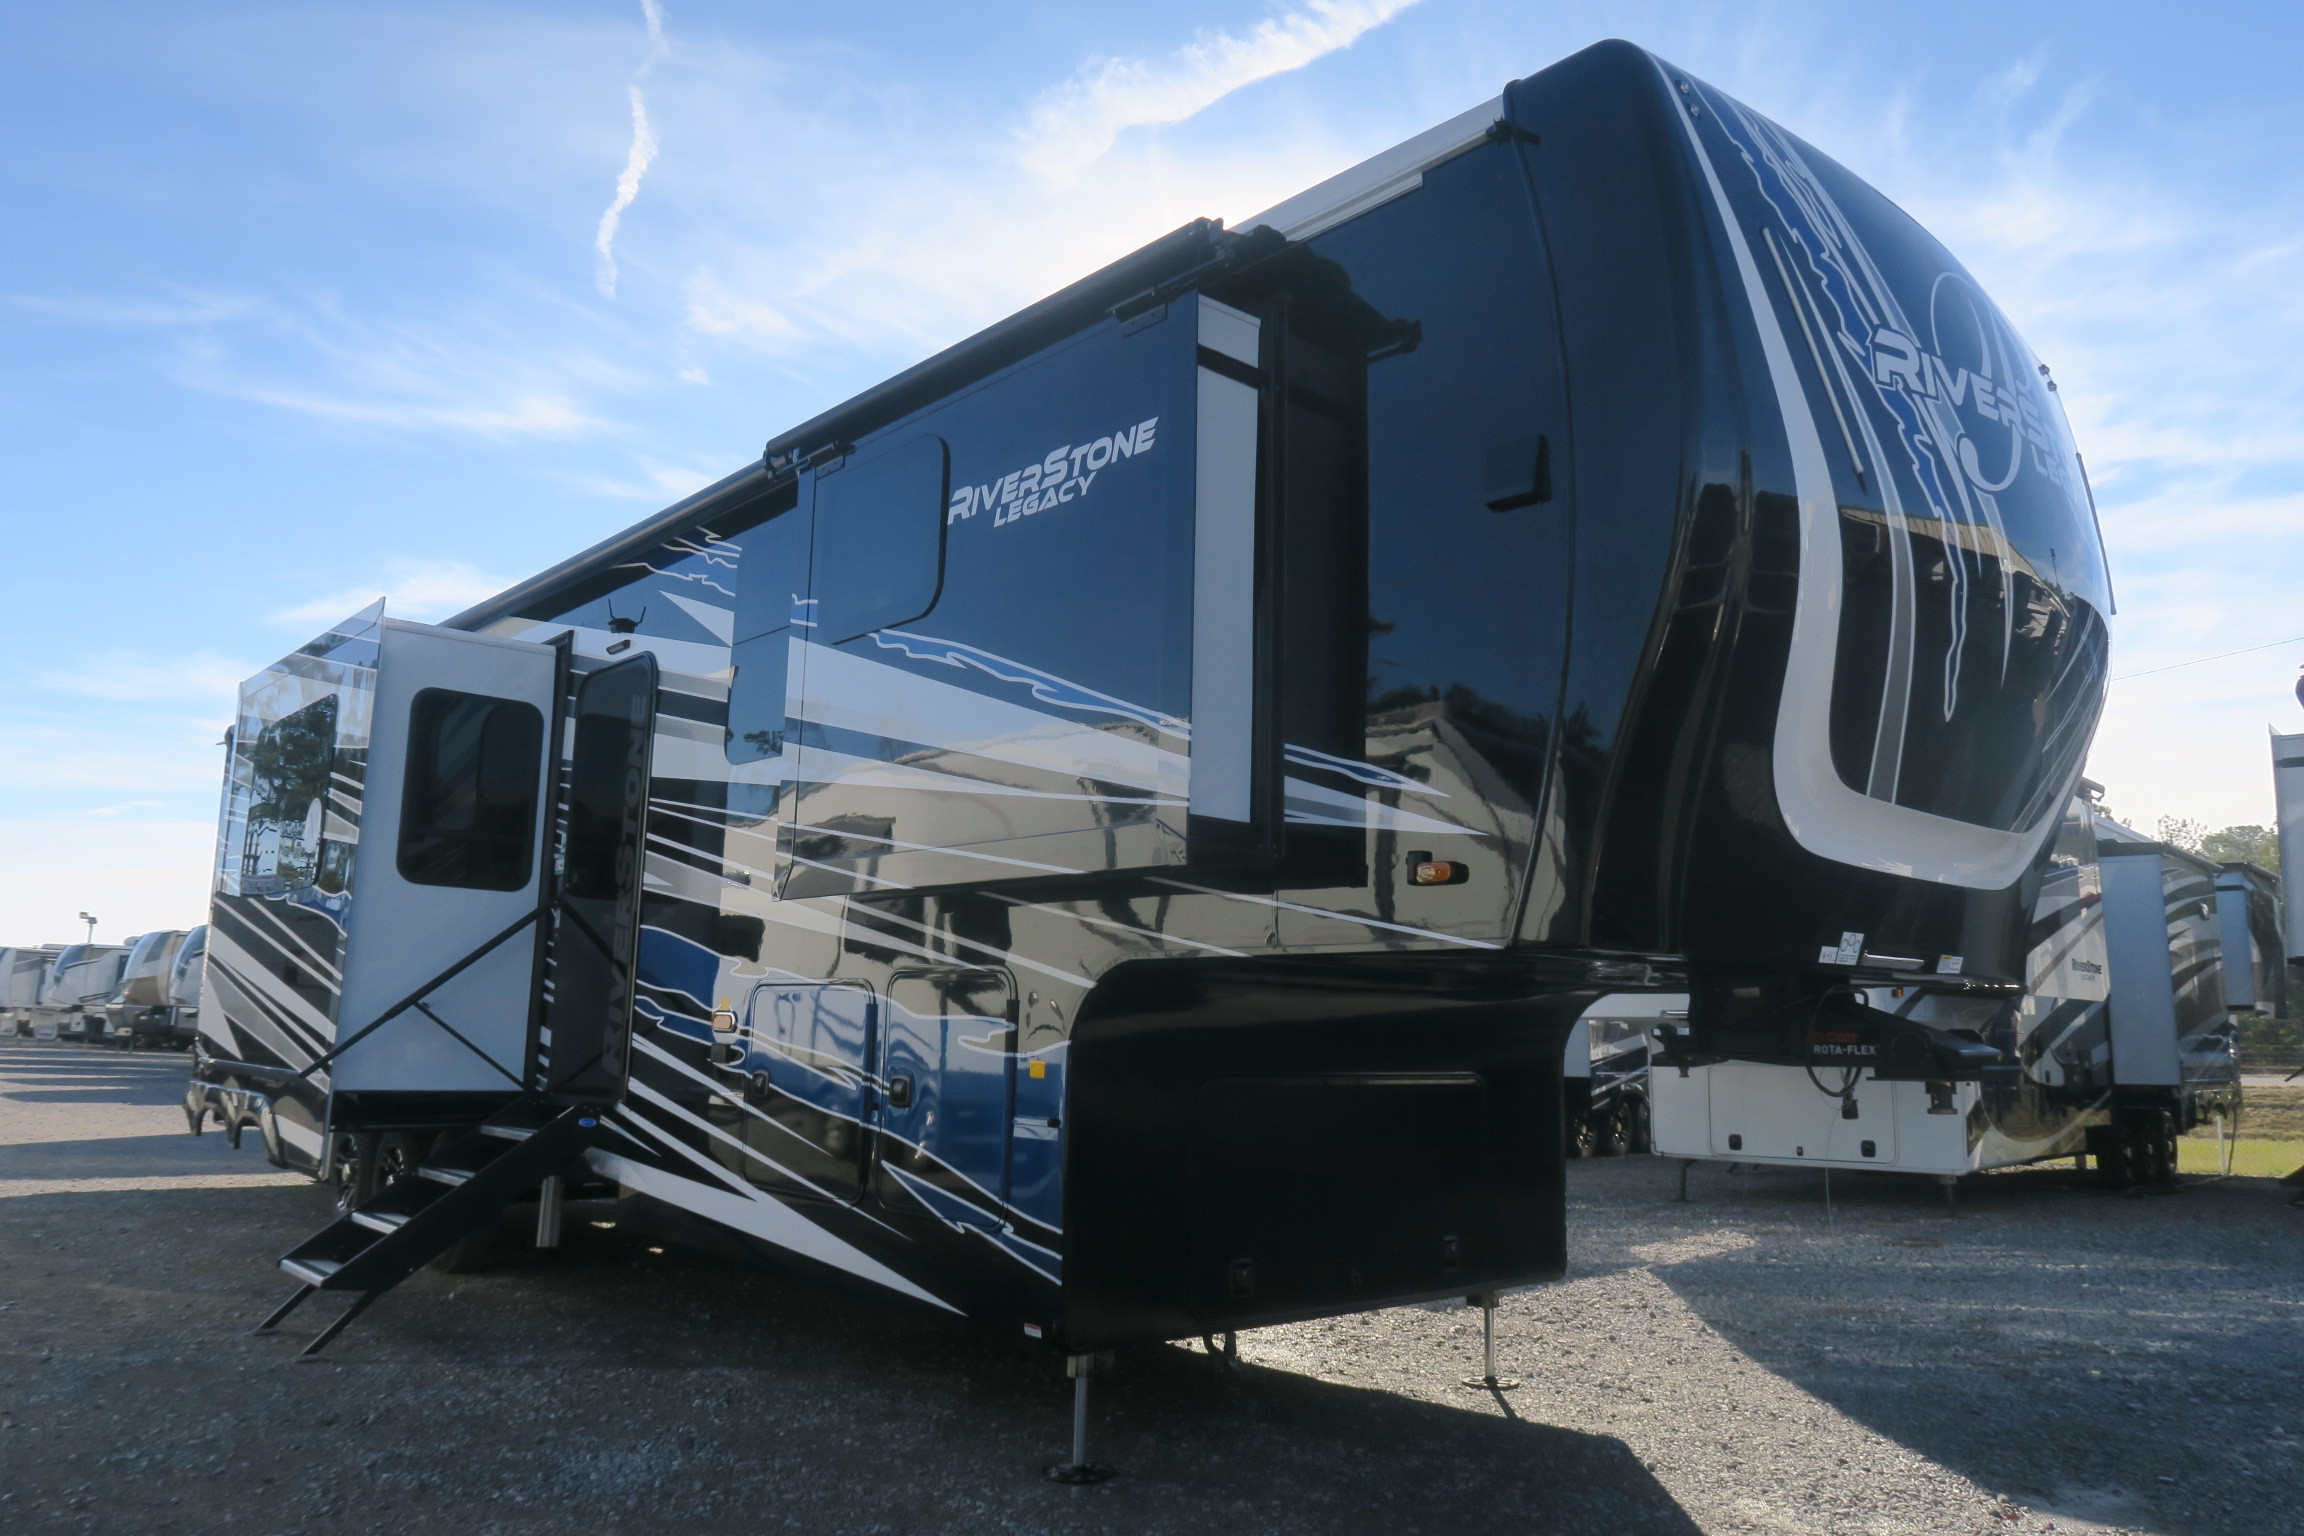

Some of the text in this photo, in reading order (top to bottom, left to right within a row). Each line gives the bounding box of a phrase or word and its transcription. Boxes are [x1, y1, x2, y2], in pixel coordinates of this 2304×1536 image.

[947, 416, 1159, 526] RIVERSTONE
[993, 471, 1098, 528] LEGACY
[1813, 1044, 1877, 1055] ROTA-FLEX
